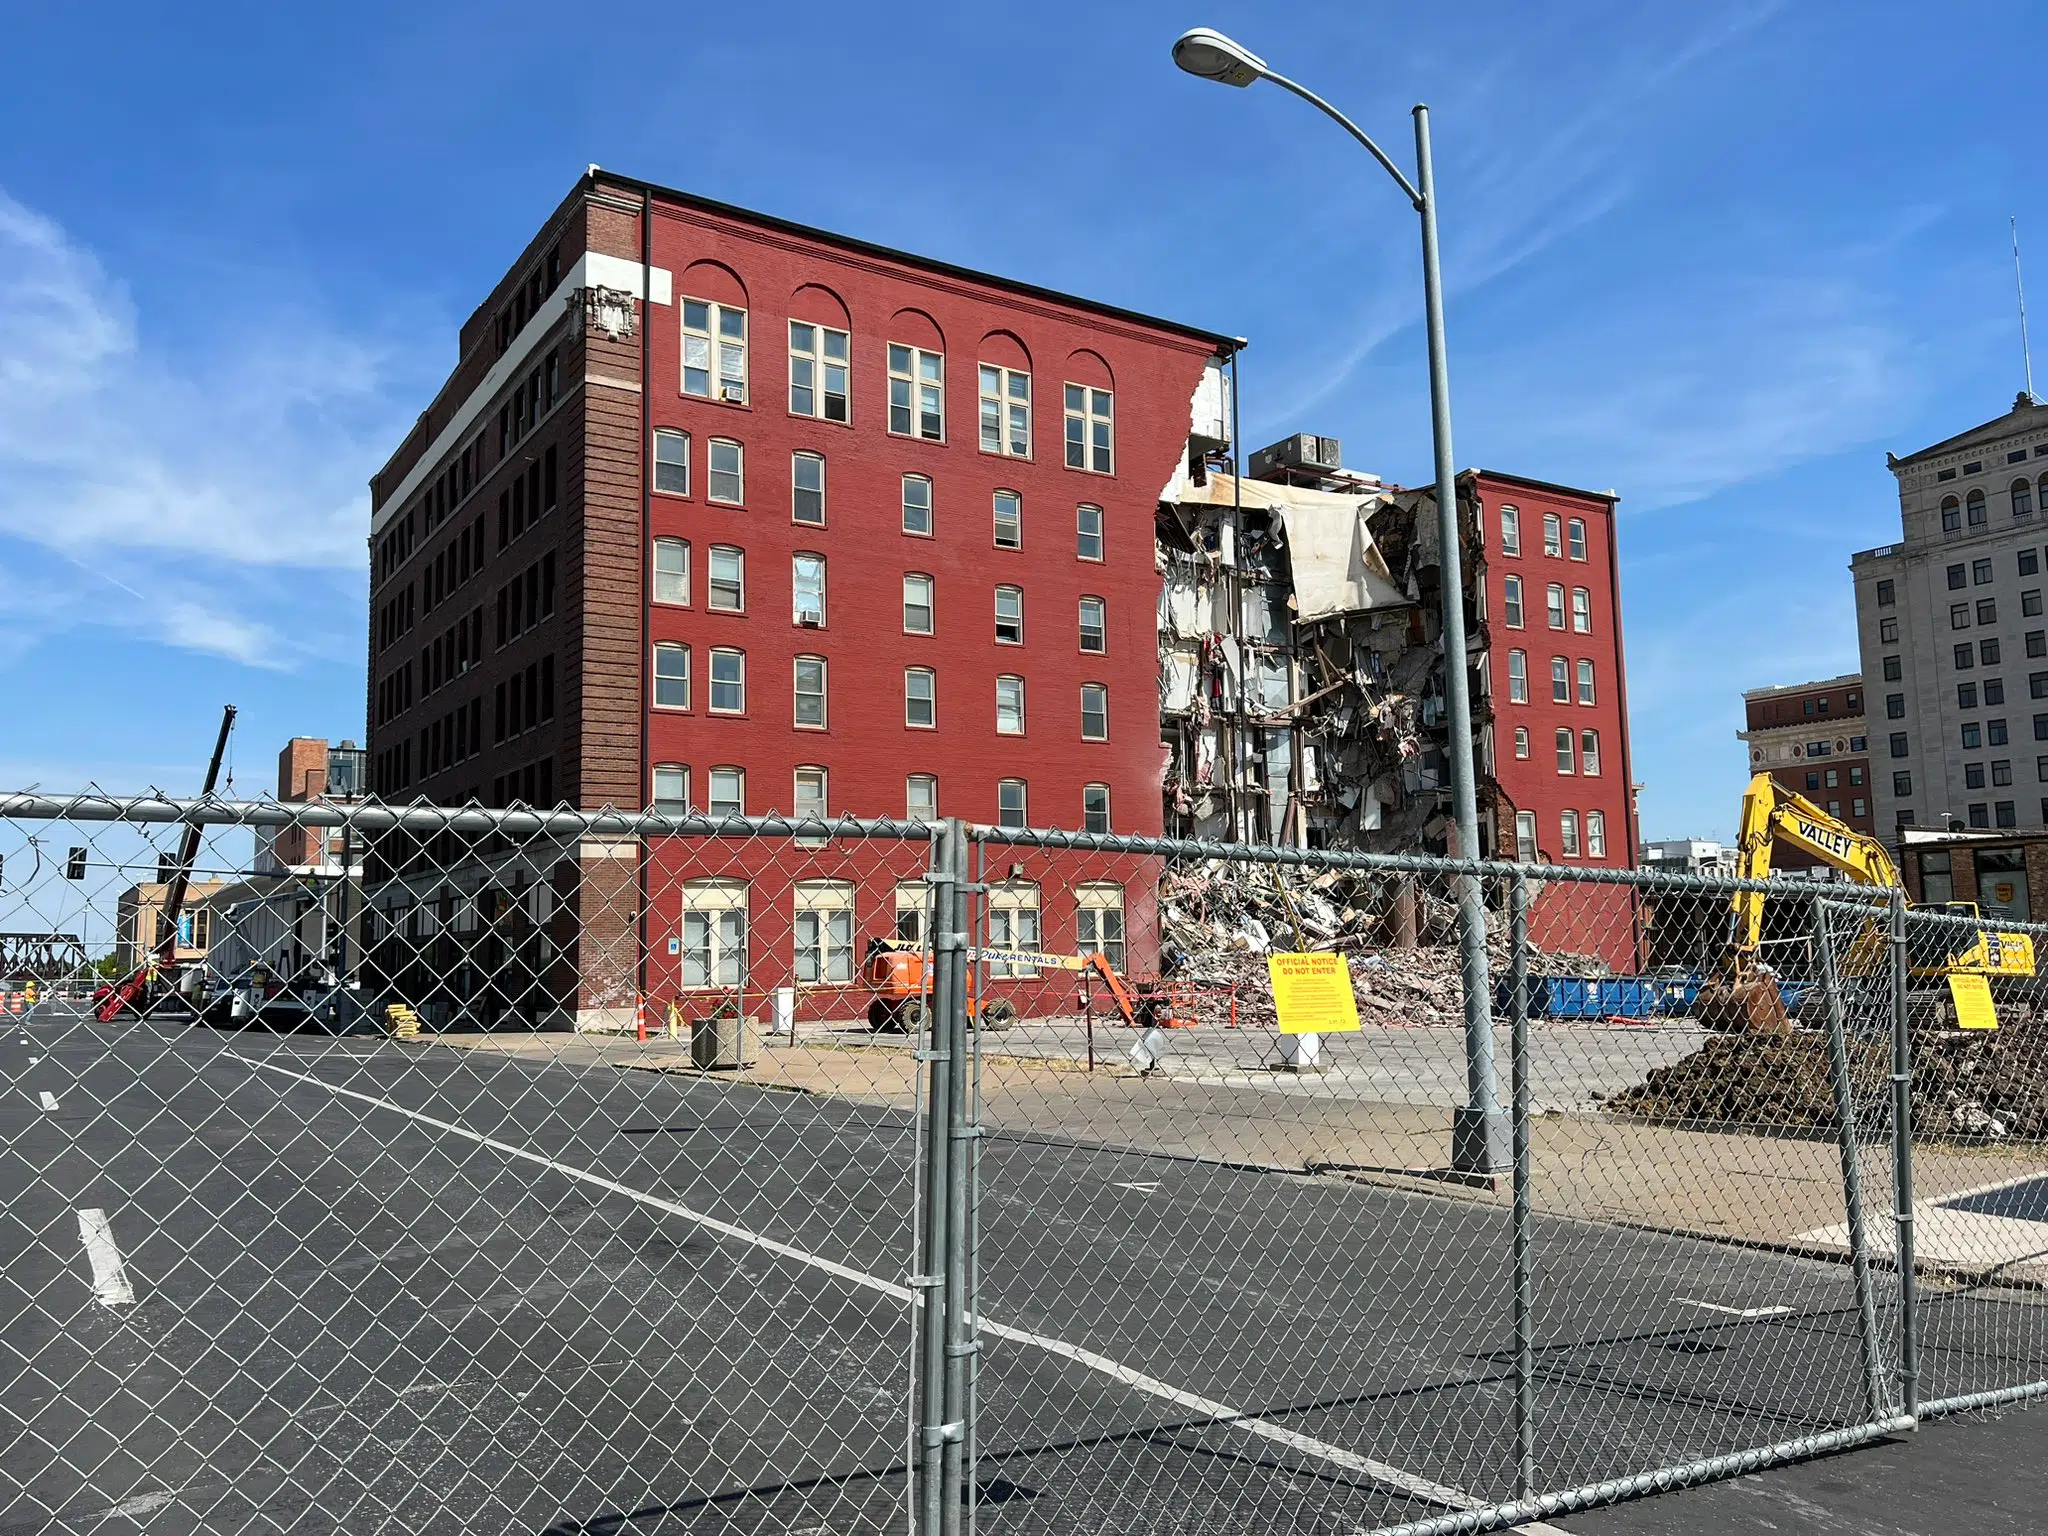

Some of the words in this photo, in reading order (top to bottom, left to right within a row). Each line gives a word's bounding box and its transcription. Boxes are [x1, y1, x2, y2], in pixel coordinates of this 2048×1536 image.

[1798, 820, 1852, 858] VALLEY
[1009, 953, 1057, 965] RENTALS
[1276, 958, 1310, 966] OFFICIAL
[1311, 958, 1338, 966] NOTICE
[1282, 967, 1293, 975] DO
[1295, 967, 1310, 975] NOT
[1312, 967, 1336, 975] ENTER
